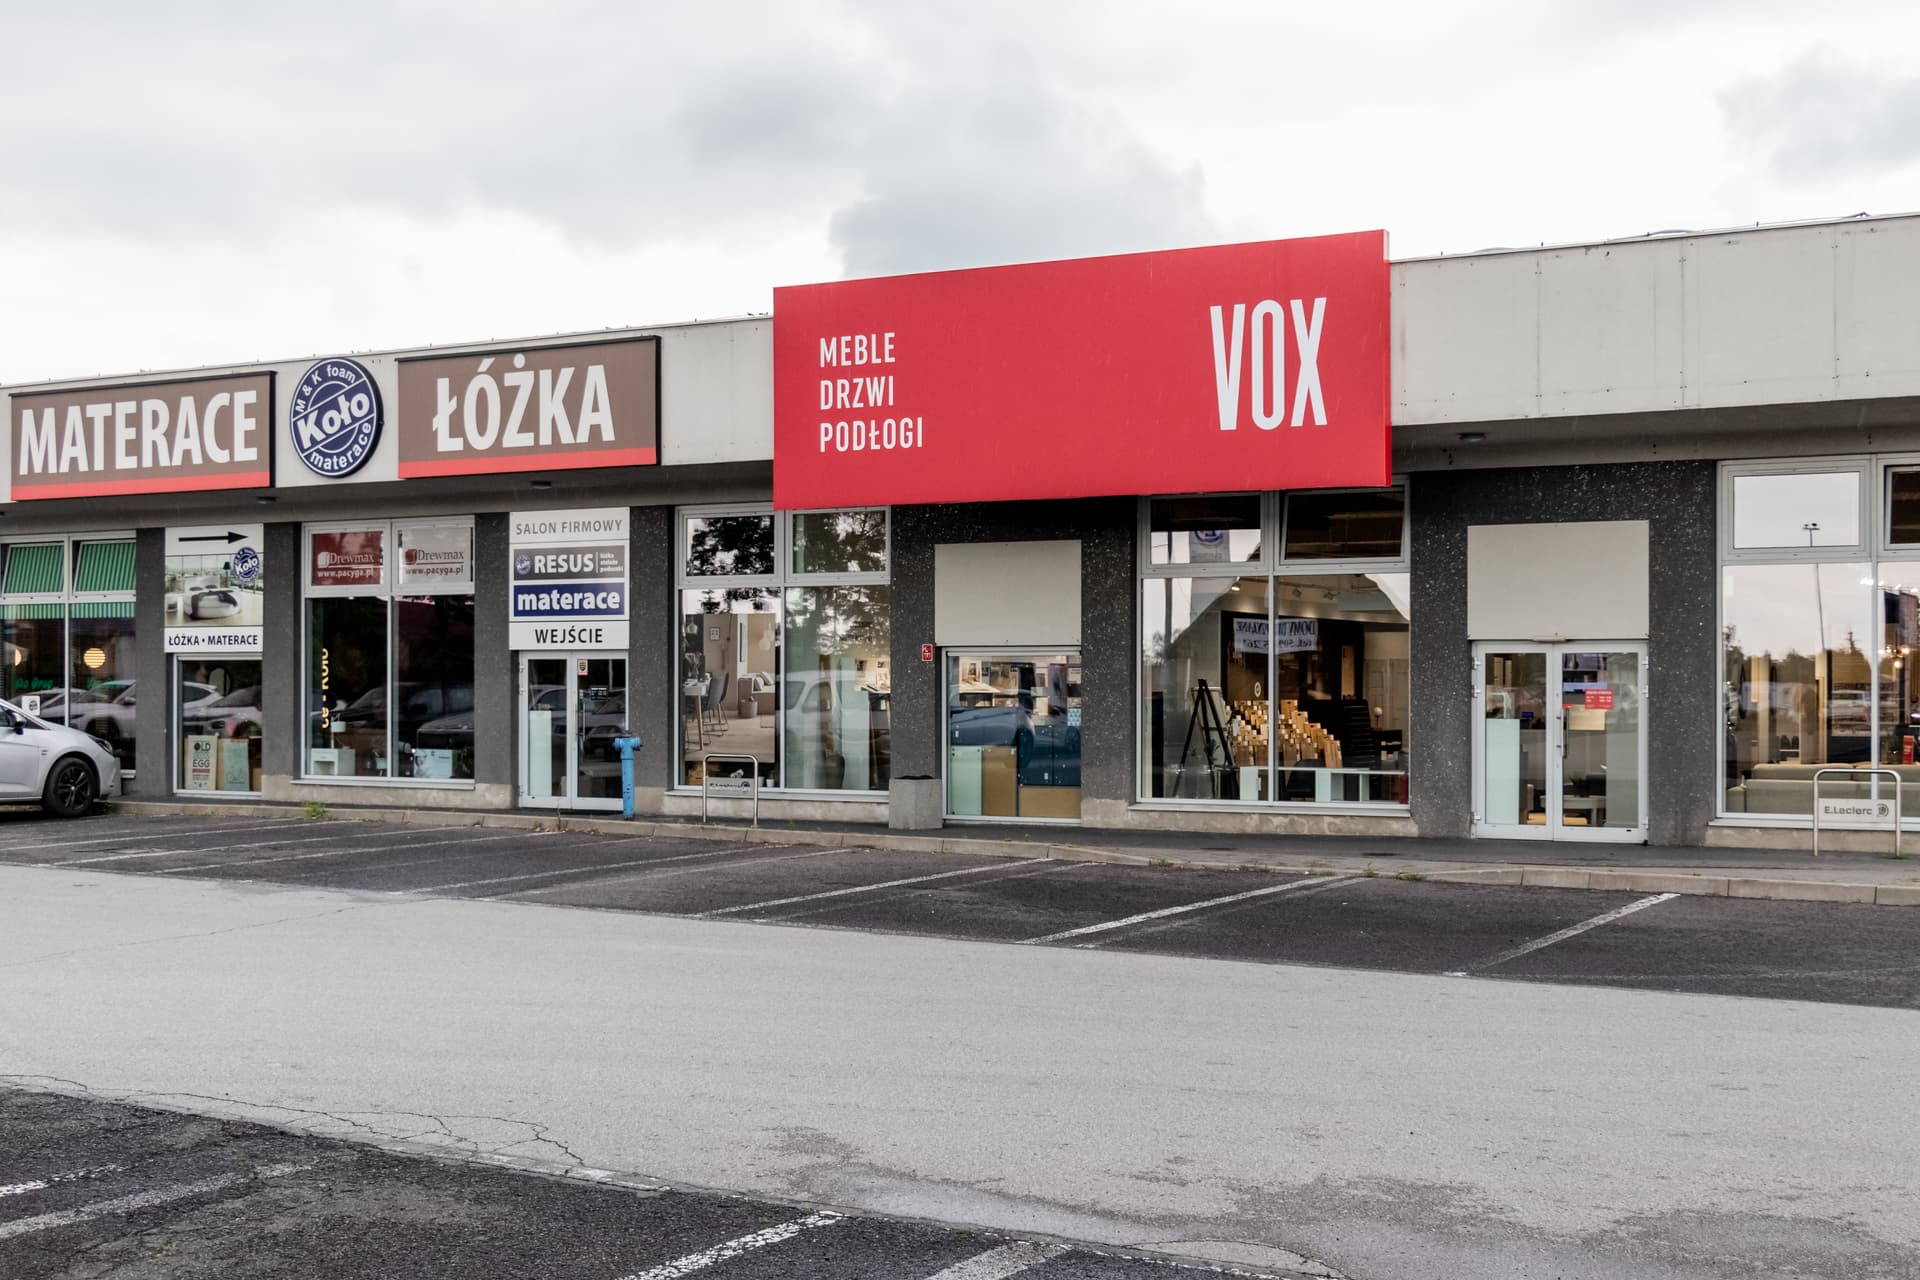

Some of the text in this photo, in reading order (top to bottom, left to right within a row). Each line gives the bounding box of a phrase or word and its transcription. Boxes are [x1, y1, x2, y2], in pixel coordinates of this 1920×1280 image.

[820, 332, 895, 368] MEBLE
[1210, 297, 1328, 430] VOX
[295, 364, 356, 413] M & K foam
[820, 375, 894, 410] DRZWI
[432, 353, 616, 452] ŁÓŻKA
[19, 390, 258, 475] MATERACE
[297, 393, 370, 450] Koło
[820, 416, 923, 453] PODŁOGI
[310, 422, 372, 470] materace
[516, 520, 623, 535] SALON FIRMOWY
[330, 552, 375, 564] Drewmax
[417, 549, 465, 561] Drewmax
[534, 553, 594, 574] RESUS
[317, 568, 374, 578] www.pacyga.pl
[405, 565, 464, 577] www.pacyga.pl
[517, 589, 620, 611] materace
[168, 633, 258, 646] ŁÓŻKA MATERACE
[535, 625, 603, 644] WEJŚCIE
[1824, 806, 1873, 816] E.Leclerc
